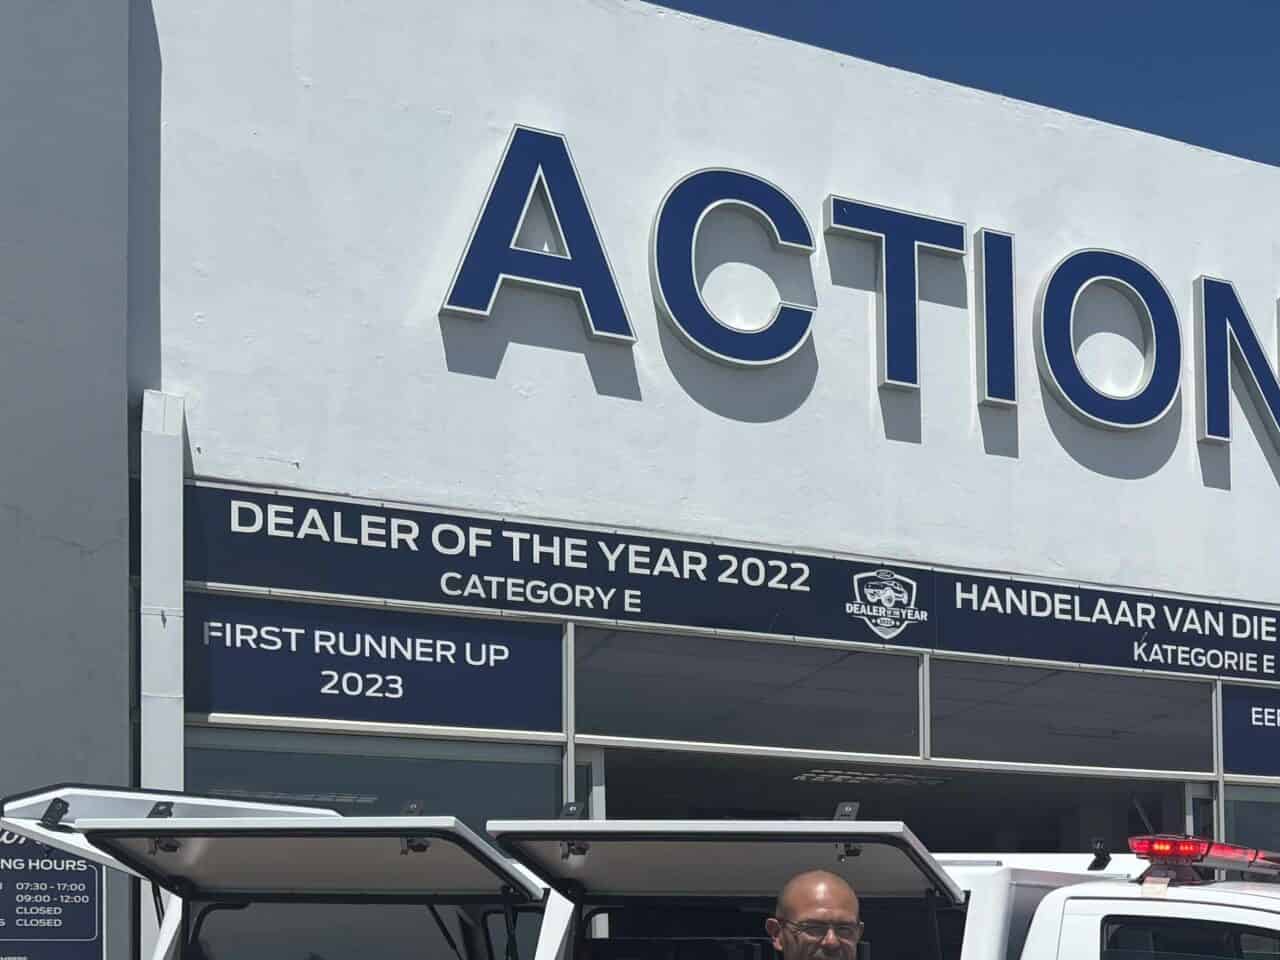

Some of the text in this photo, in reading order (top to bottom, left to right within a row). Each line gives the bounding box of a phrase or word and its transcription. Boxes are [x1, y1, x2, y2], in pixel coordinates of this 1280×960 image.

[230, 499, 812, 592] DEALER OF THE YEAR 2022
[439, 571, 642, 613] CATEGORY E
[845, 602, 886, 617] DEALER
[900, 607, 928, 621] YEAR
[954, 582, 1157, 629] HANDELAAR
[1163, 607, 1225, 638] VAN
[1231, 614, 1277, 642] DIE
[203, 621, 510, 668] FIRST RUNNER UP
[1132, 640, 1276, 675] KATEGORIE E
[319, 669, 404, 700] 2023
[28, 858, 88, 871] HOURS
[16, 882, 48, 891] 07:30
[57, 883, 86, 892] 17:00
[60, 895, 89, 904] 12:00
[16, 906, 62, 915] CLOSED
[16, 919, 62, 927] CLOSED
